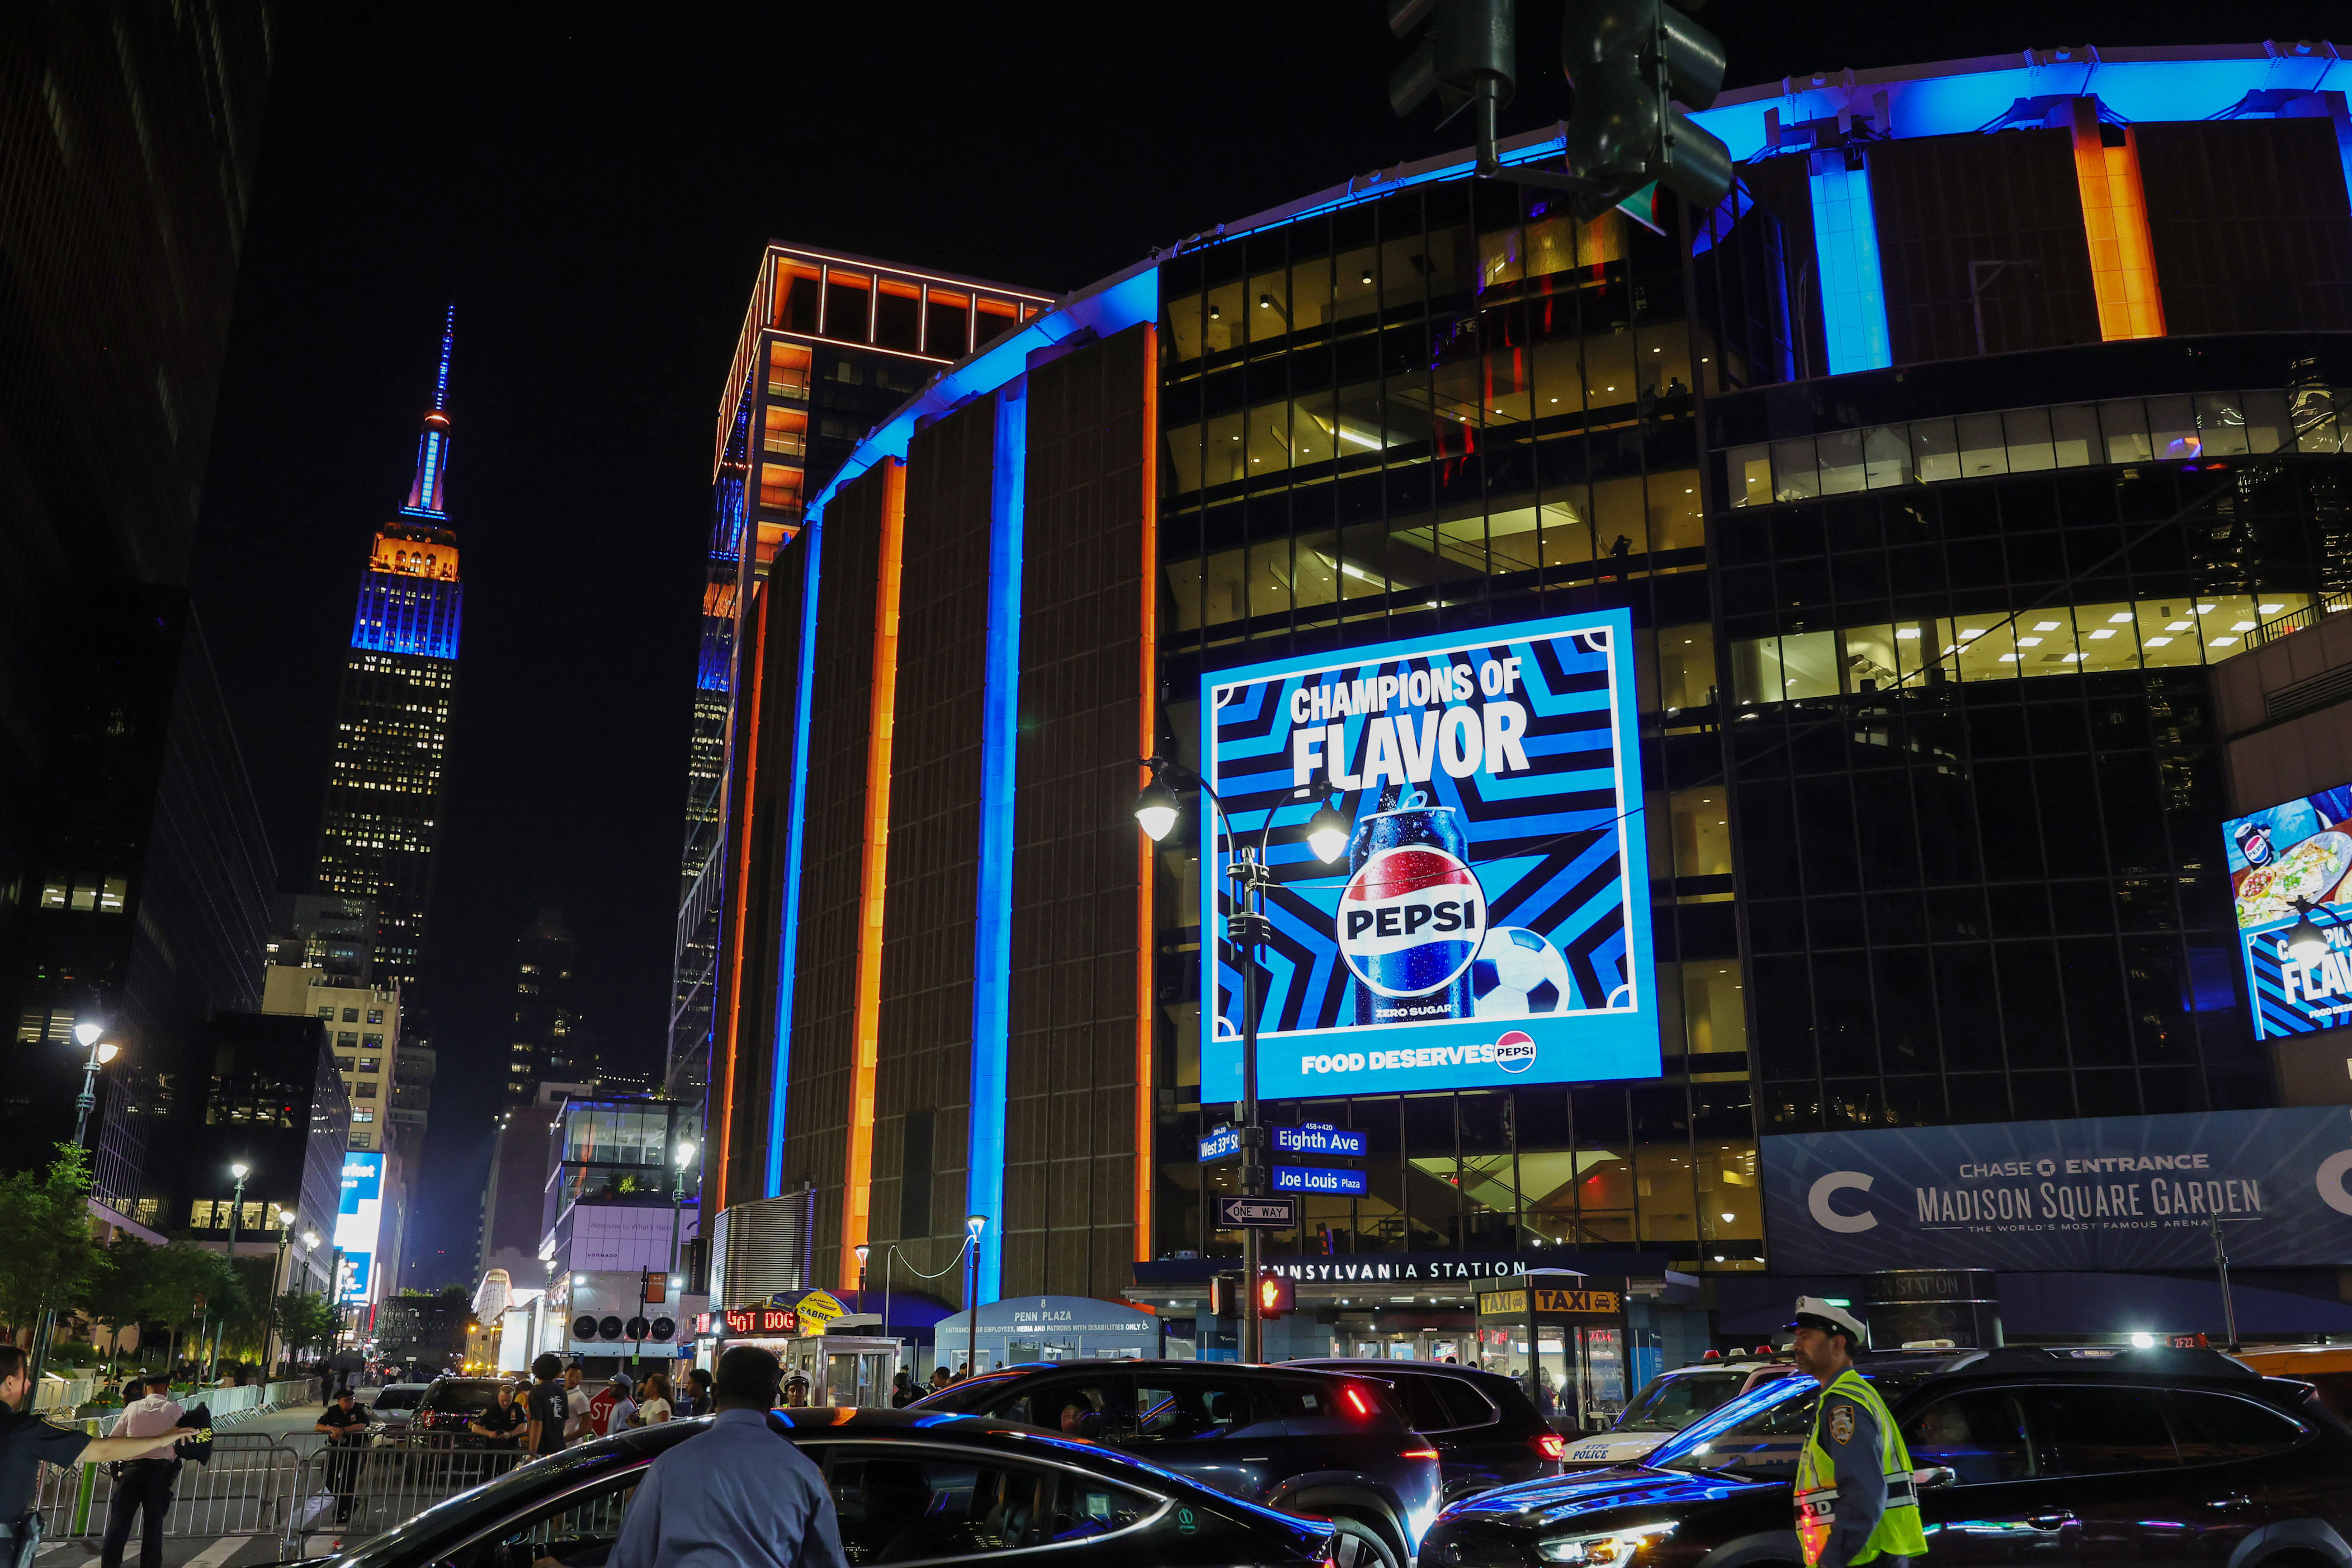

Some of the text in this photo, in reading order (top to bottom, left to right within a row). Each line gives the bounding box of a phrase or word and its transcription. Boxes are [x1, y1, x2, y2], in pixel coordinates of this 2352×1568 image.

[1290, 657, 1522, 724] CHAMPIONS OF
[1292, 700, 1530, 799] FLAVOR
[1347, 900, 1475, 941] PEPSI
[1376, 1004, 1452, 1018] ZERO SUGAR
[2308, 1007, 2332, 1019] FOOD
[1302, 1043, 1534, 1074] FOOD DESERVES PEPSI
[1201, 1134, 1239, 1158] West 33rd St
[1279, 1130, 1359, 1151] Eighth Ave
[1959, 1154, 2209, 1178] CHASE ENTRANCE
[1279, 1171, 1361, 1189] Joe Louis Plaza
[1808, 1170, 1878, 1234] C
[1916, 1178, 2261, 1222] MADISON SQUARE GARDEN
[1233, 1206, 1283, 1217] ONE WAY
[1998, 1224, 2055, 1232] WORLD'S
[2061, 1222, 2096, 1231] MOST
[2103, 1221, 2157, 1229] FAMOUS
[1260, 1260, 1526, 1280] NNSYLVANIA STATION
[1896, 1276, 1959, 1295] STATION
[1041, 1298, 1046, 1308] 8
[1481, 1292, 1512, 1313] TAXI
[1538, 1291, 1591, 1311] TAXI
[764, 1312, 794, 1329] DOG
[799, 1306, 835, 1321] SABRE
[1014, 1311, 1072, 1321] PENN PLAZA
[2174, 1337, 2194, 1348] 2F22
[591, 1402, 612, 1421] ST
[1572, 1450, 1609, 1460] POLICE
